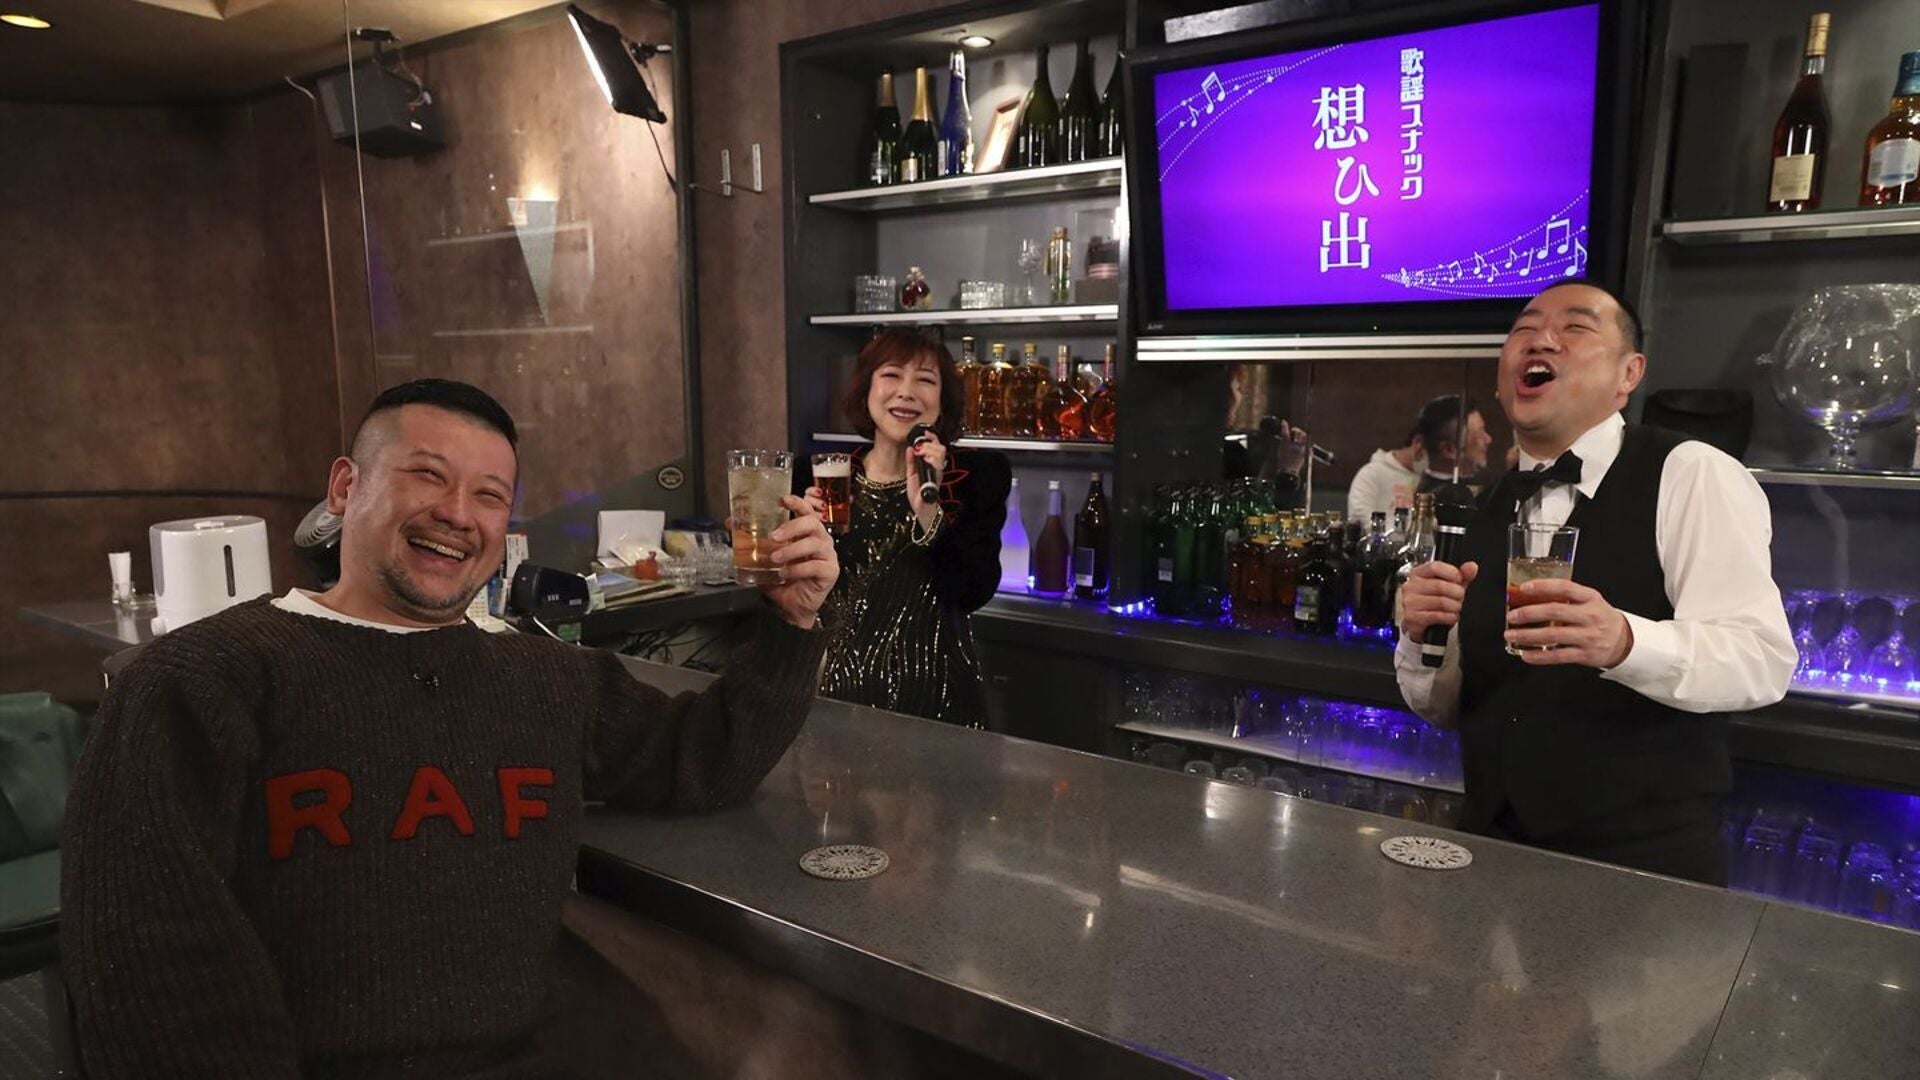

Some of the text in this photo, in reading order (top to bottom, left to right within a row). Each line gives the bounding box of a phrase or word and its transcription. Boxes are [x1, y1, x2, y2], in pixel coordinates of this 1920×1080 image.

[1311, 83, 1380, 273] 想ひ出
[1400, 48, 1424, 200] 歌謡スナック
[264, 766, 555, 860] RAF
